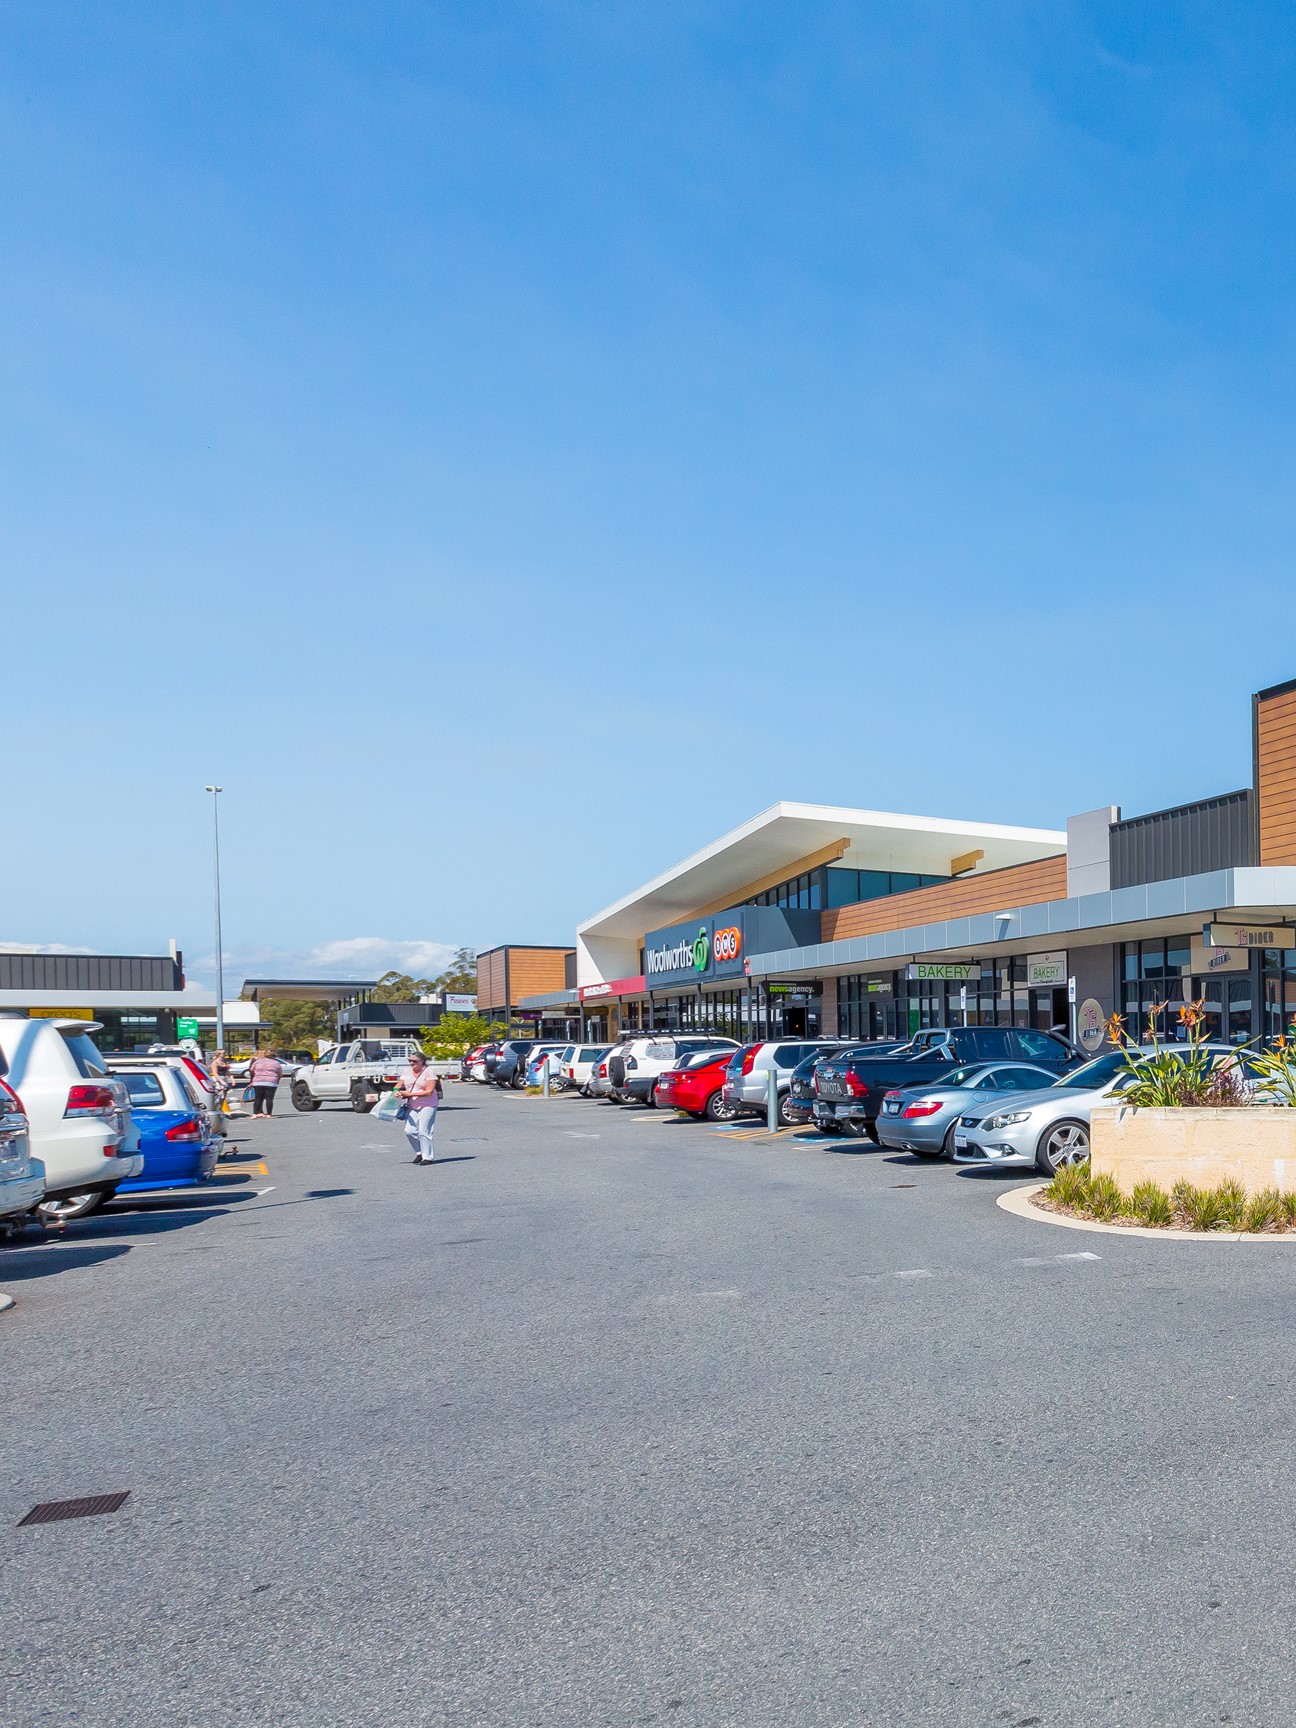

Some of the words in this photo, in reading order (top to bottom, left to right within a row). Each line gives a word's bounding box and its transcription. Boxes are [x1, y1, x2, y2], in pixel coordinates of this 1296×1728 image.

[1249, 931, 1274, 945] DINER
[647, 939, 693, 974] Woolworths
[918, 965, 971, 979] BAKERY
[1033, 966, 1060, 979] BAKERY
[820, 1082, 842, 1094] TOYOTA
